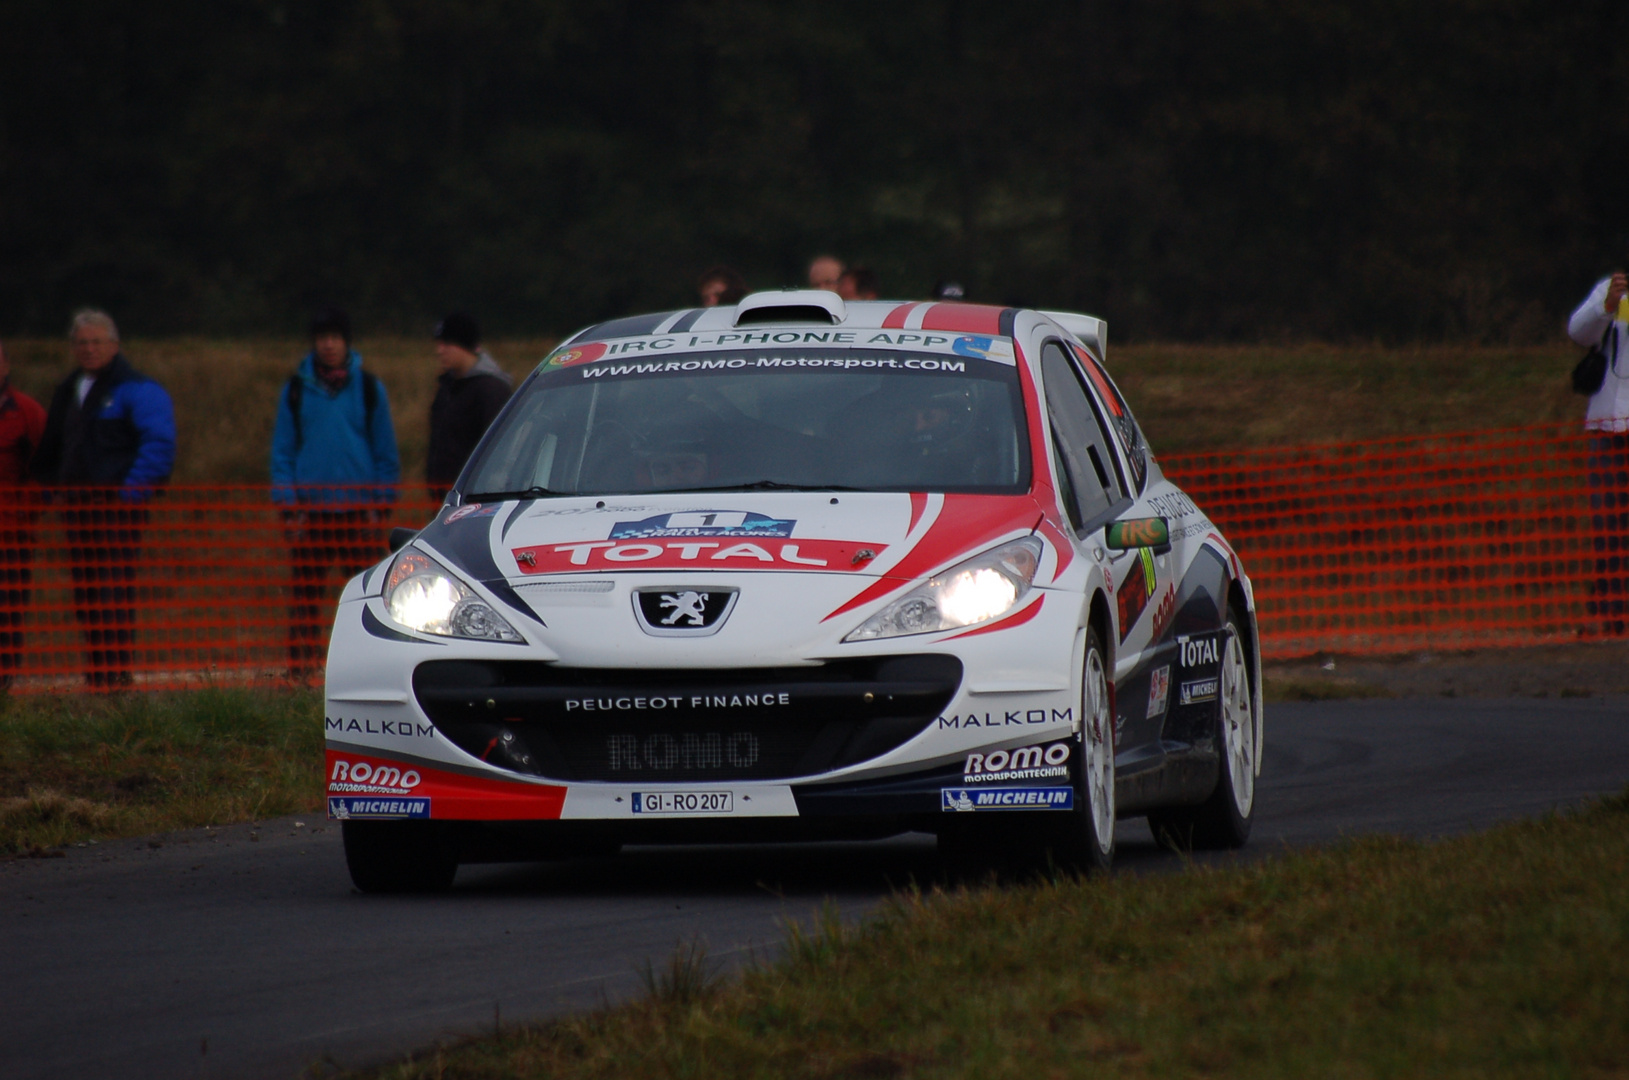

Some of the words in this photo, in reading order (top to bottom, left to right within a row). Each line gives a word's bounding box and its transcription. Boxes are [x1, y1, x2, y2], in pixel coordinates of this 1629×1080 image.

[609, 338, 675, 355] IRC
[689, 332, 855, 347] I-PHONE
[867, 333, 949, 347] APP
[1147, 491, 1195, 519] PEUGEO
[700, 513, 718, 526] 1
[554, 541, 828, 566] TOTAL
[1178, 635, 1219, 668] TOTAL
[565, 697, 683, 711] PEUGEOT
[691, 693, 790, 708] FINANCE
[325, 717, 434, 738] MALKOM
[938, 708, 1073, 730] MALKOM
[606, 732, 760, 770] ROMO
[964, 743, 1070, 774] ROMO
[331, 760, 421, 788] ROMO
[964, 766, 1067, 783] MOTORSPORTTECHNIK
[351, 801, 425, 814] MICHELIN
[977, 792, 1067, 805] MICHELIN
